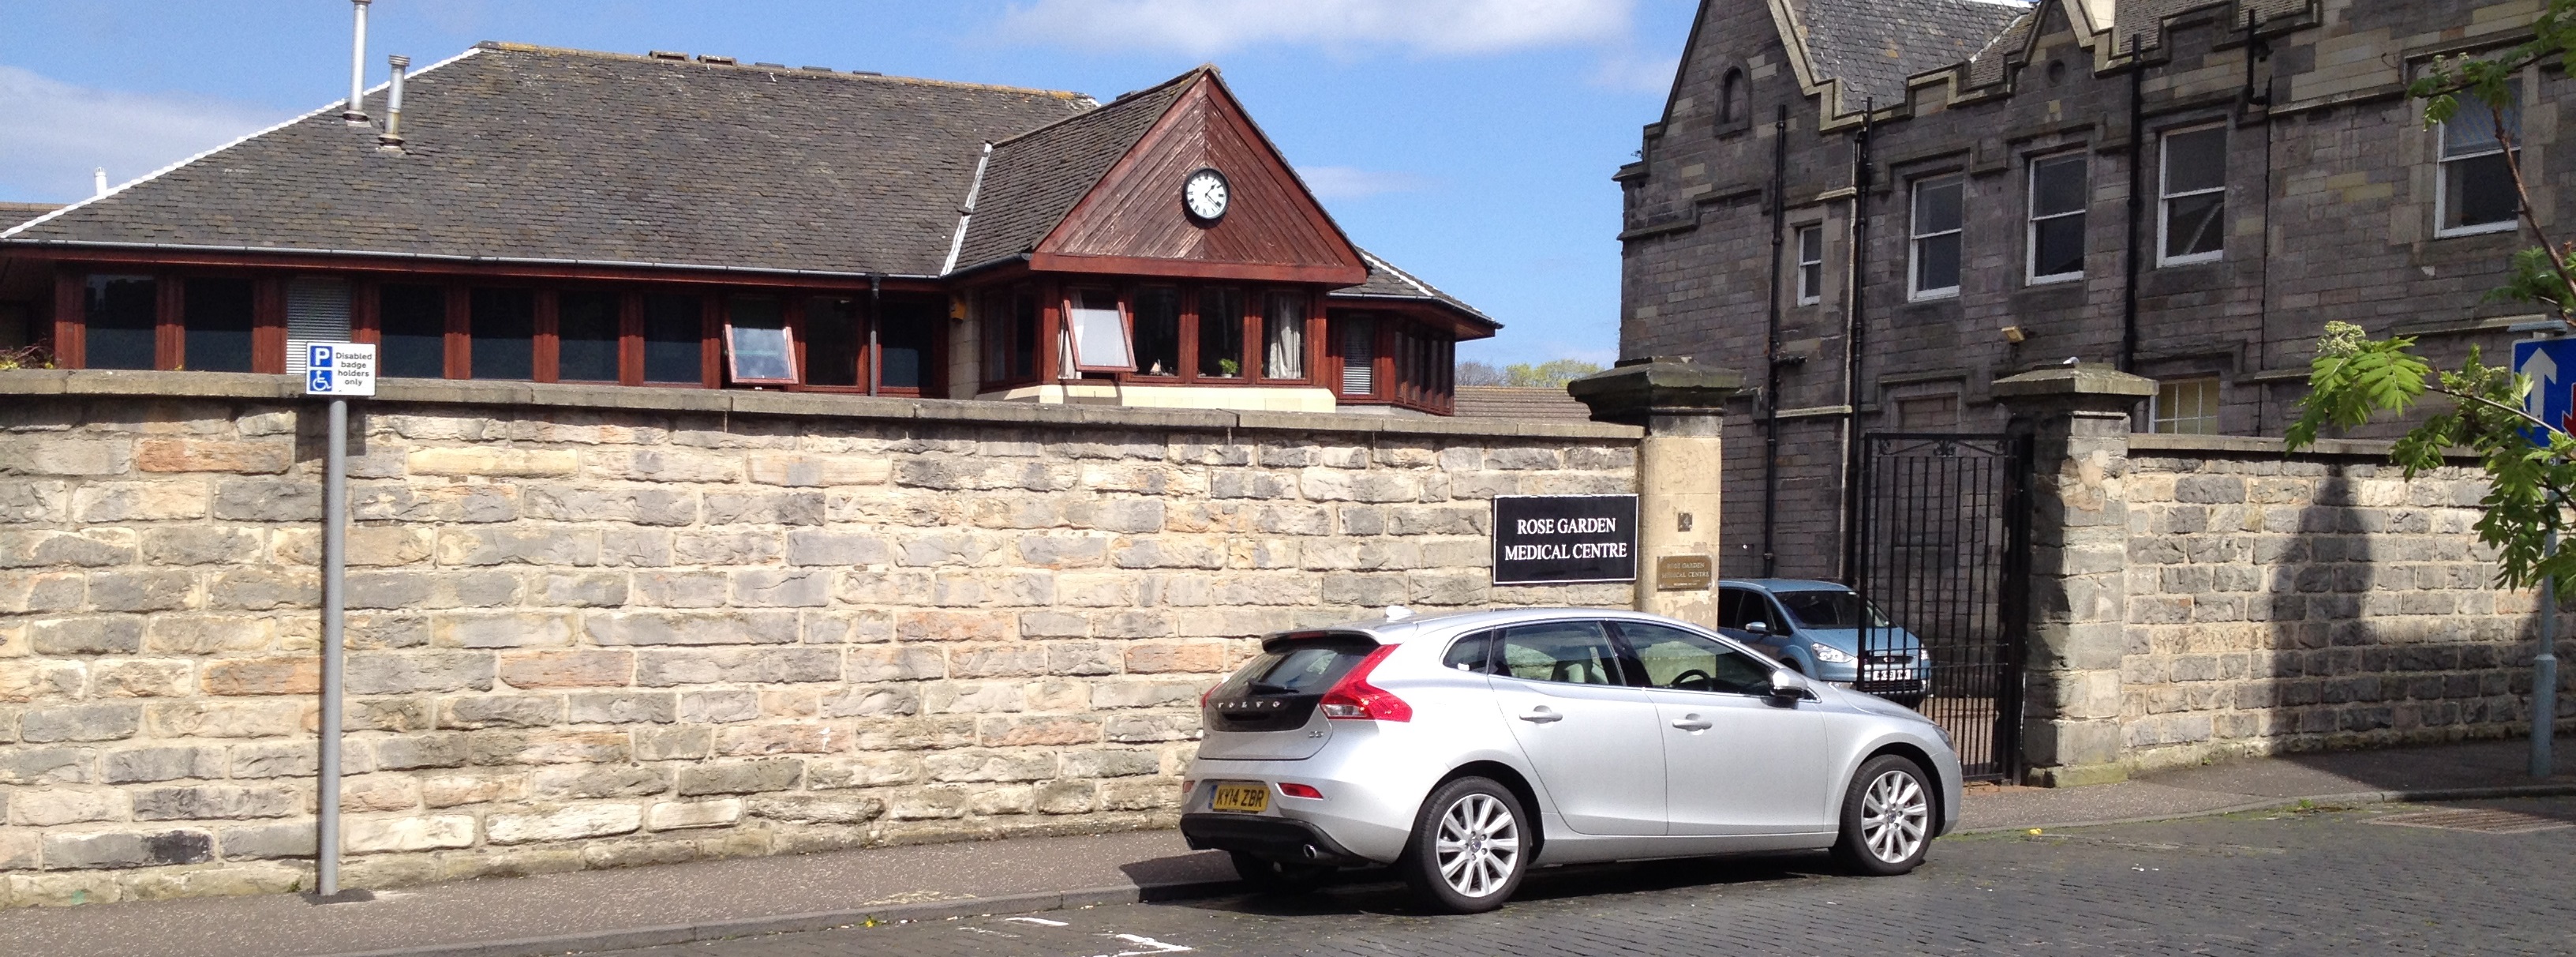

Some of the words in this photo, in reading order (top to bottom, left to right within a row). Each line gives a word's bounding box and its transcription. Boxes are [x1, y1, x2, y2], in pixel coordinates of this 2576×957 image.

[316, 347, 330, 366] P
[1517, 519, 1555, 535] ROSE
[1557, 517, 1616, 534] GARDEN
[1504, 544, 1571, 561] MEDICAL
[1572, 542, 1627, 559] CENTRE
[1218, 700, 1280, 709] VOLVO
[1216, 788, 1240, 806] KY14
[1241, 790, 1265, 807] ZBR
